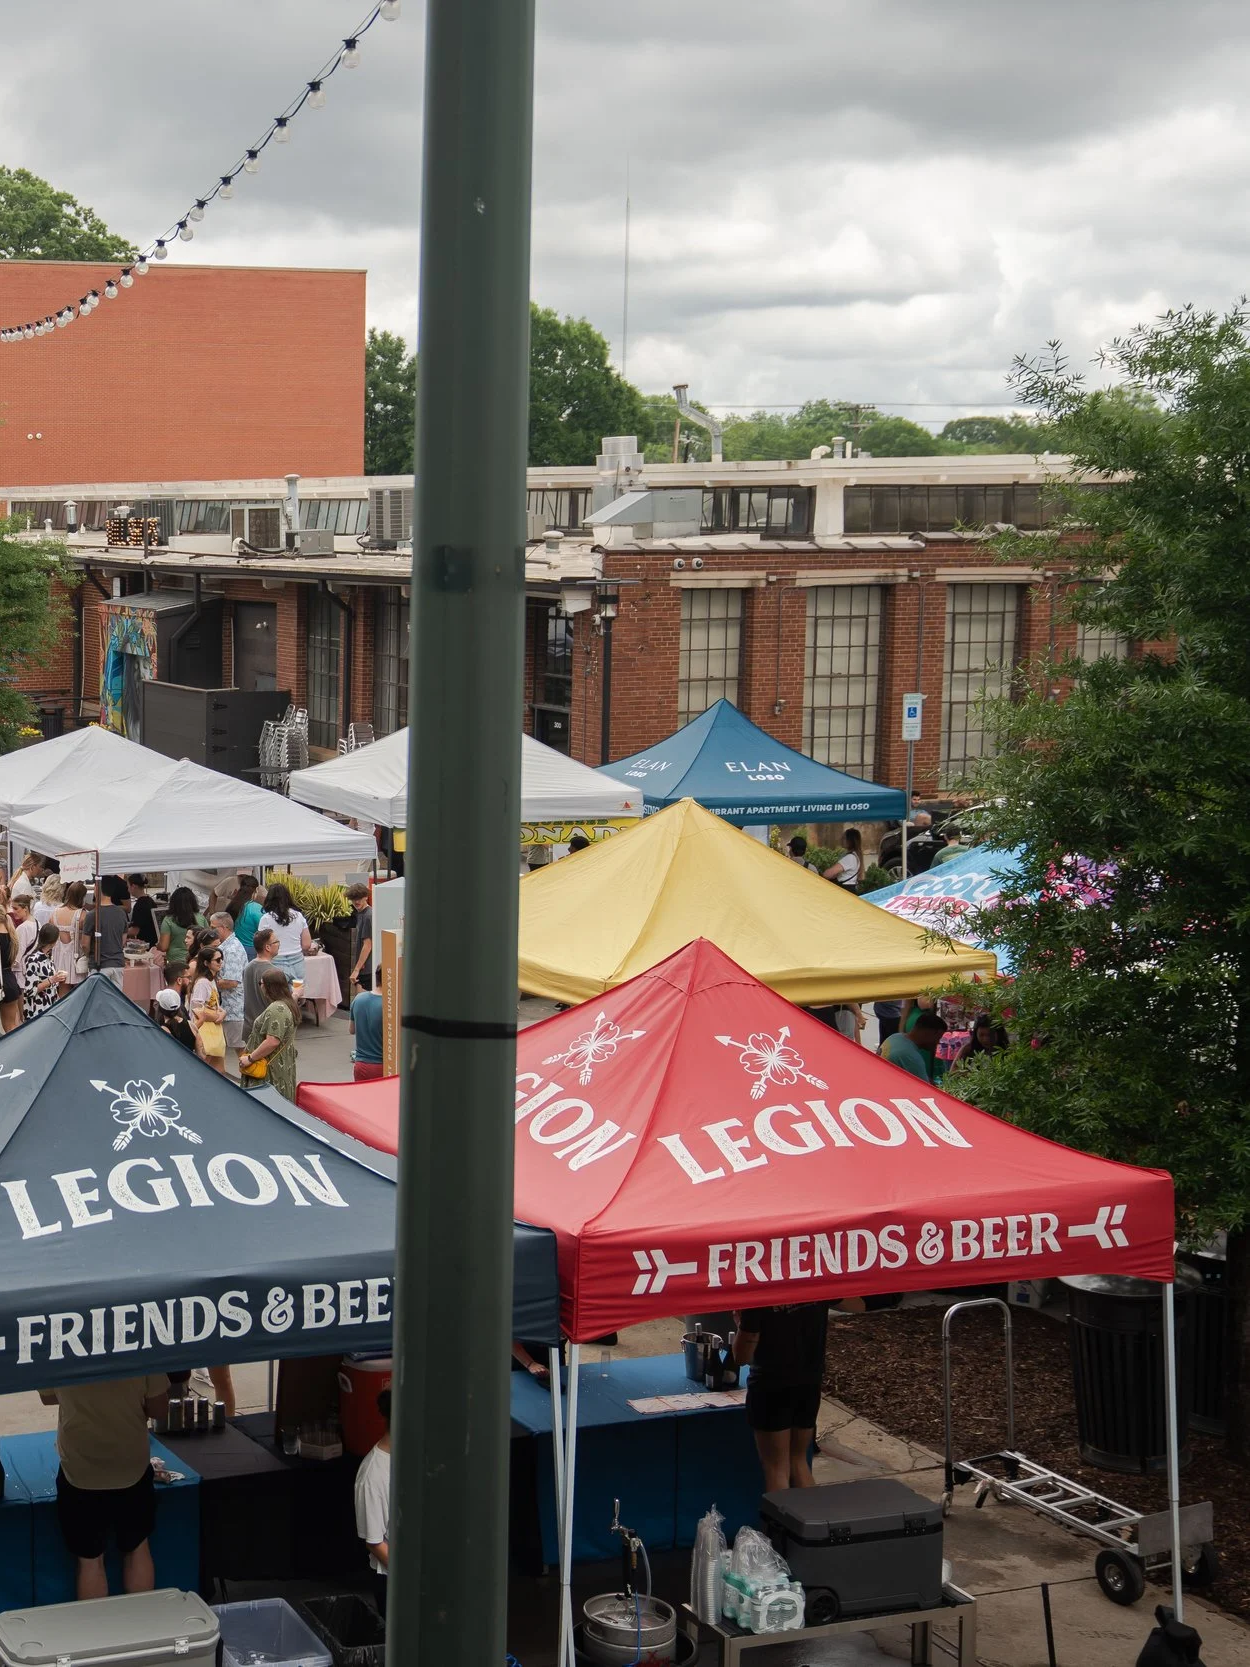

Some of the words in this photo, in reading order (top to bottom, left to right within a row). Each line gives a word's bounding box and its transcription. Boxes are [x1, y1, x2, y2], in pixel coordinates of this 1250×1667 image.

[553, 721, 562, 729] 300
[624, 770, 648, 778] LOSO
[630, 758, 673, 772] ELAN
[725, 761, 792, 773] ELAN
[746, 806, 800, 815] APARTMENT
[802, 805, 832, 813] LIVING
[834, 804, 844, 812] IN
[845, 803, 870, 812] LOSO
[516, 1072, 638, 1172] ION
[657, 1097, 973, 1185] LEGION
[0, 1152, 350, 1241] LEGION
[708, 1224, 908, 1287] FRIENDS
[915, 1221, 945, 1266] &
[951, 1212, 1062, 1262] BEER
[16, 1290, 253, 1364] FRIENDS
[261, 1286, 296, 1334] &
[302, 1277, 392, 1330] BEE
